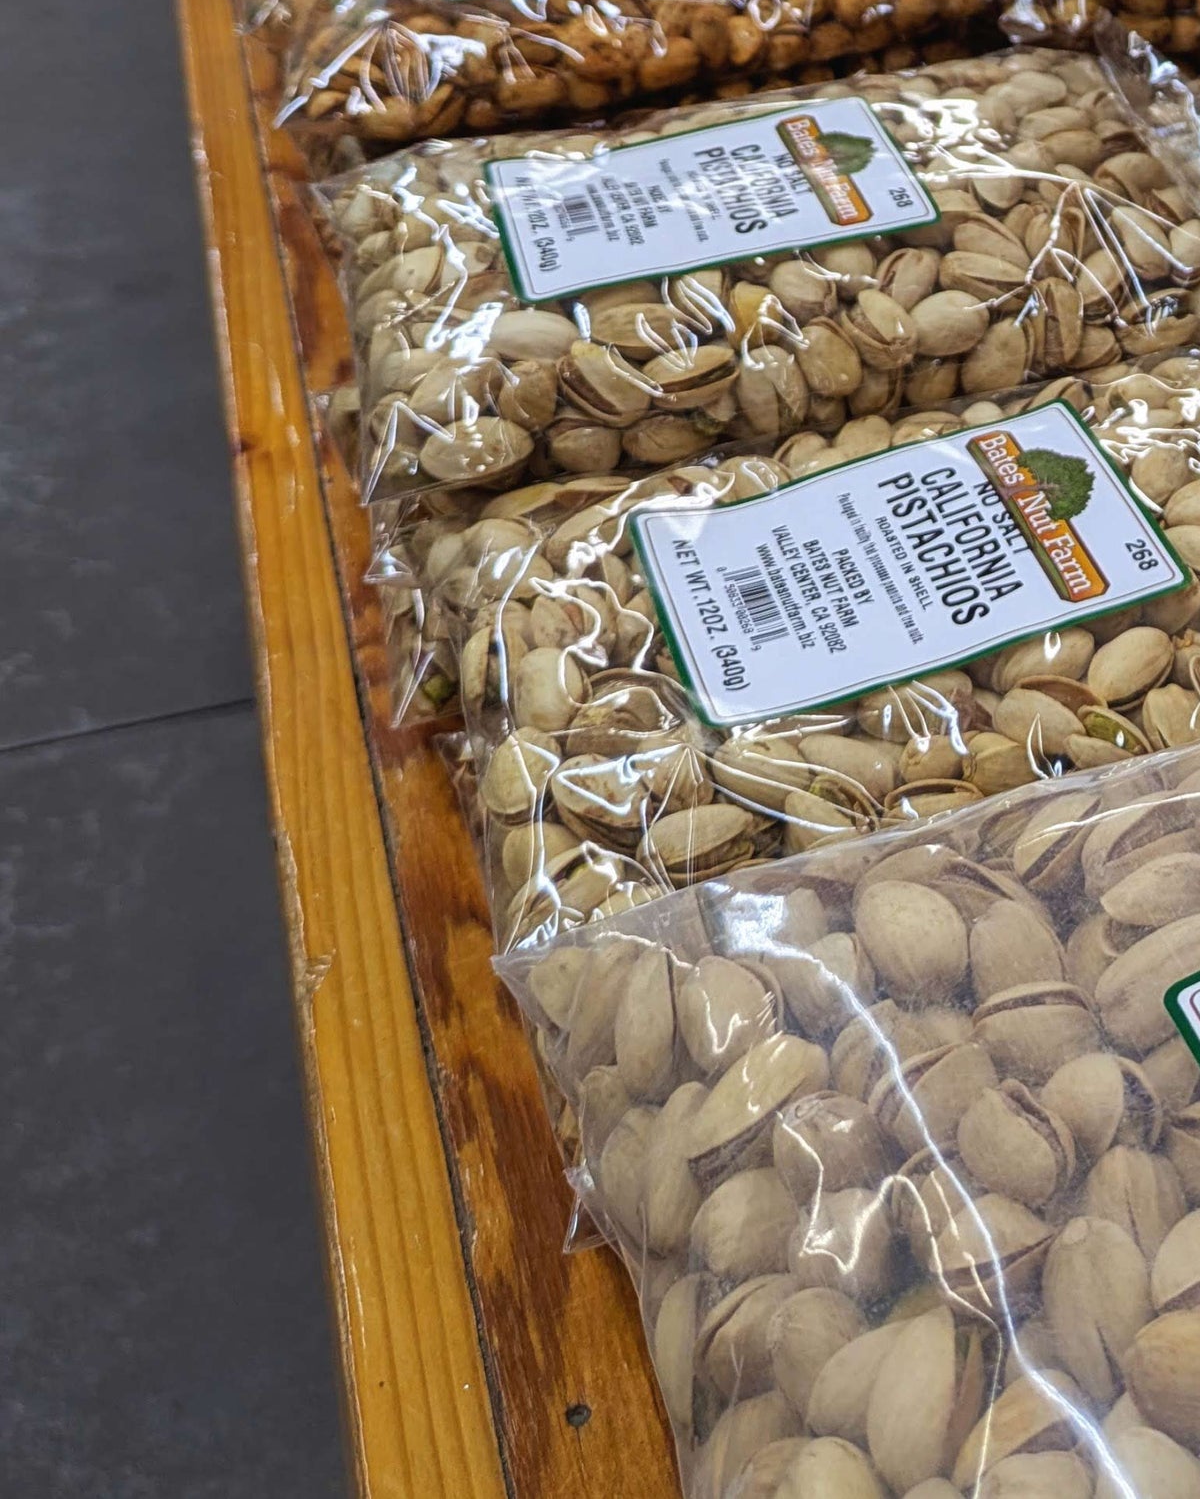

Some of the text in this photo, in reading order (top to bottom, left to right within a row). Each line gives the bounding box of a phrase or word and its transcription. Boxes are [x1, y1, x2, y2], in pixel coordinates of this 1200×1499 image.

[693, 145, 769, 234] PISTACHIOS
[730, 143, 800, 221] CALIFORNIA
[786, 118, 860, 222] Bates Farm
[887, 187, 915, 209] 268
[533, 236, 563, 273] (340g)
[877, 470, 990, 626] PISTACHIOS
[920, 466, 1025, 602] CALIFORNIA
[972, 480, 1032, 555] NO SALT
[979, 433, 1092, 594] Bates Nut Farm
[1125, 539, 1159, 571] 268
[755, 543, 816, 650] www.batesnutfarm.biz
[771, 524, 848, 655] VALLEY CENTER, CA 92082
[802, 538, 860, 629] BATES NUT FARM
[832, 547, 876, 606] PACKED BY
[875, 515, 934, 612] ROASTED IN SHELL
[672, 539, 700, 566] NET
[710, 644, 751, 691] (340g)
